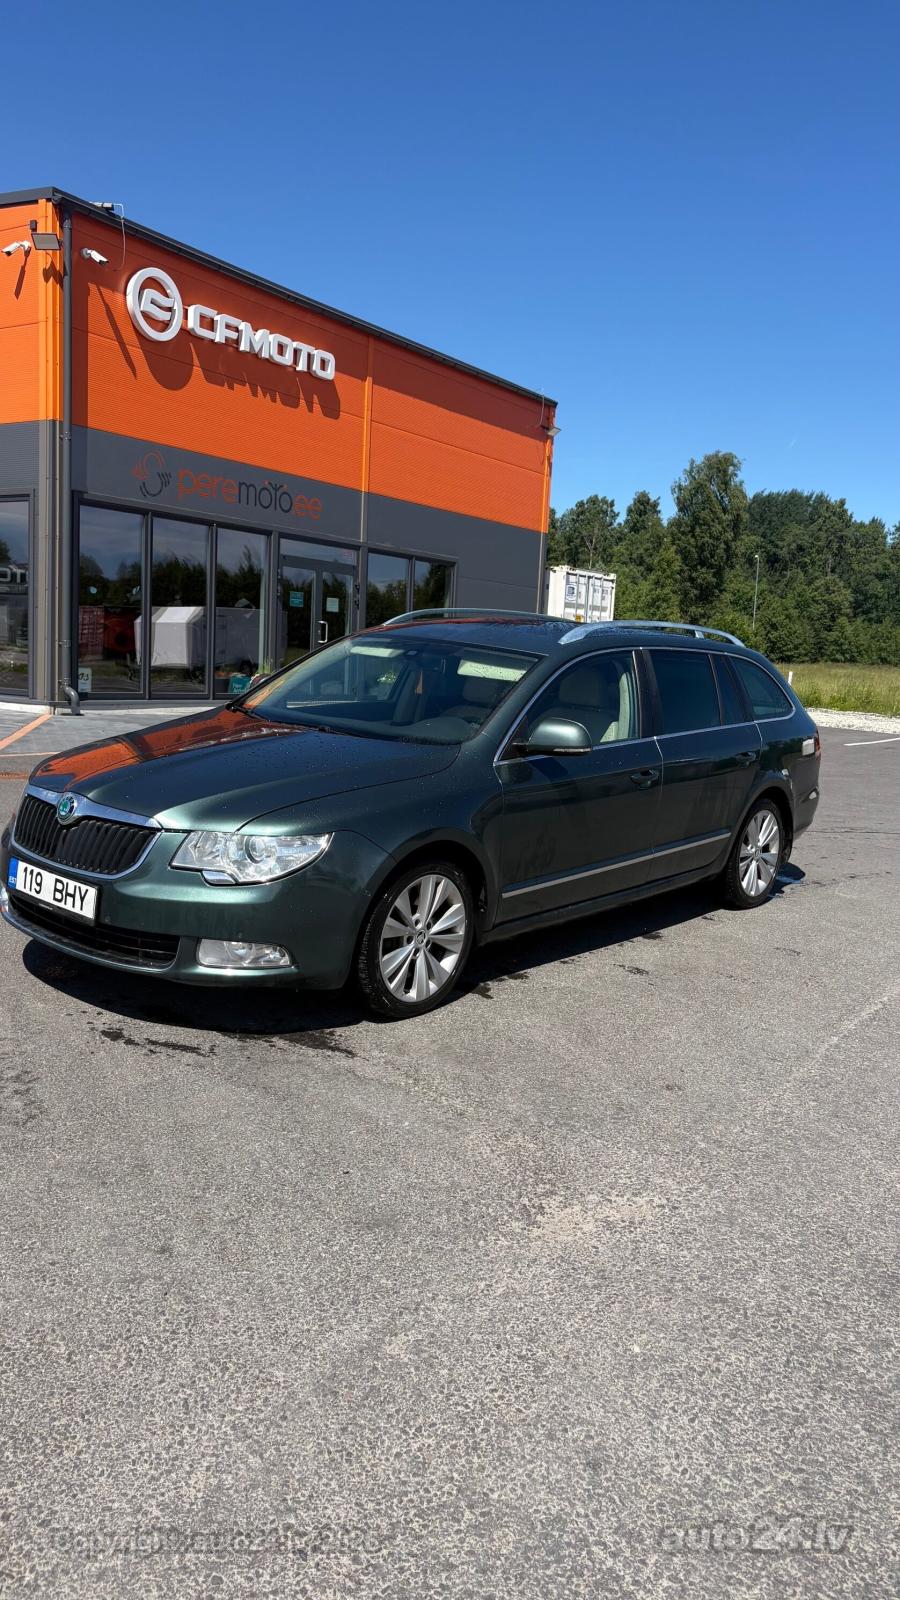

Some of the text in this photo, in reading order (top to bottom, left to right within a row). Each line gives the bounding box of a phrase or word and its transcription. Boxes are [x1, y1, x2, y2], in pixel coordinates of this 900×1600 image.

[187, 304, 336, 381] CFMOTO
[23, 866, 89, 912] 119 BHY
